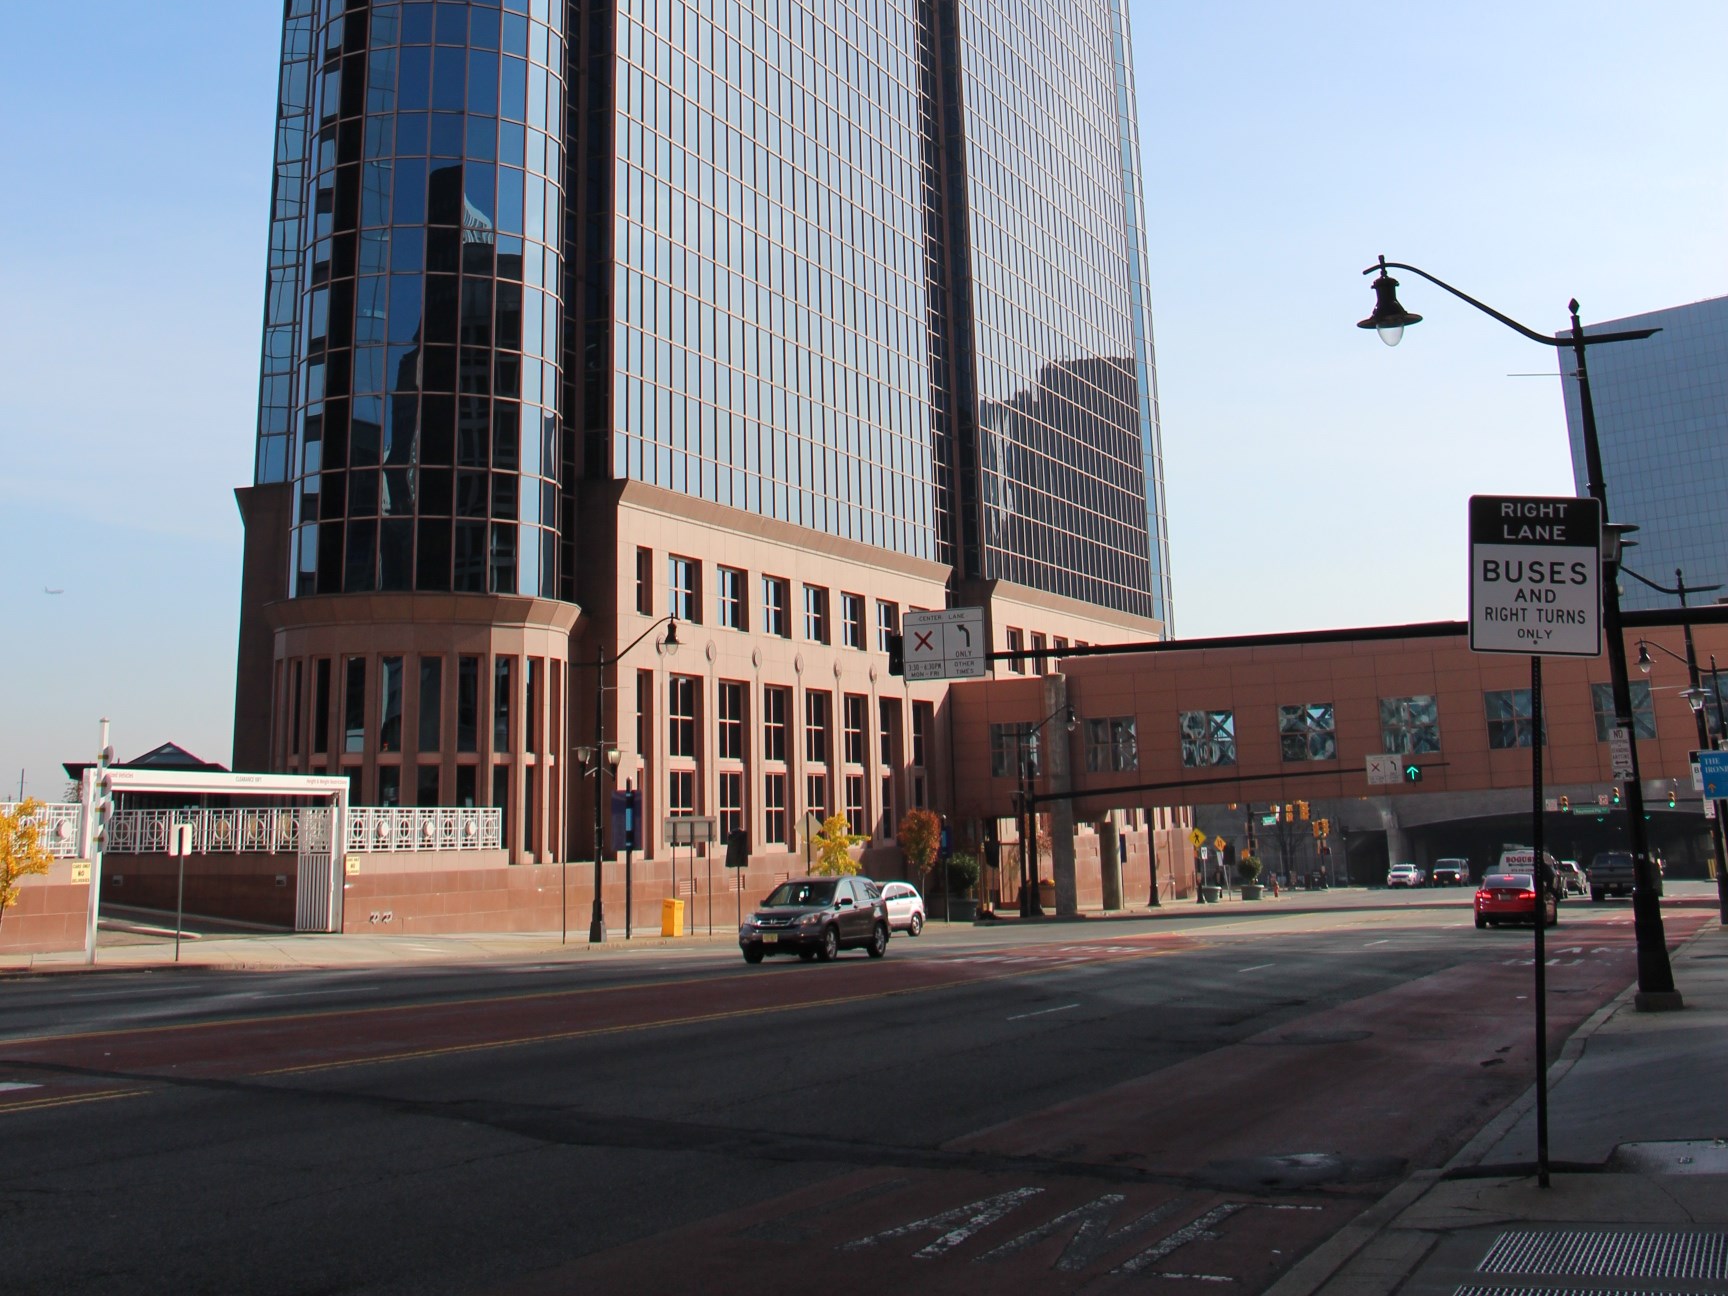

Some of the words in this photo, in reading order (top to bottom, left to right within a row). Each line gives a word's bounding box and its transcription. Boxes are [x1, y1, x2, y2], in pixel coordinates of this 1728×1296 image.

[1501, 502, 1568, 519] RIGHT
[1503, 525, 1566, 541] LANE
[1482, 559, 1588, 585] BUSES
[1514, 588, 1557, 604] AND
[1484, 606, 1528, 623] RIGHT
[1536, 607, 1587, 625] TURNS
[1517, 628, 1553, 640] ONLY
[955, 650, 973, 658] ONLY
[1613, 730, 1623, 739] NO
[1704, 757, 1721, 765] THE
[730, 1177, 1323, 1283] LANE
